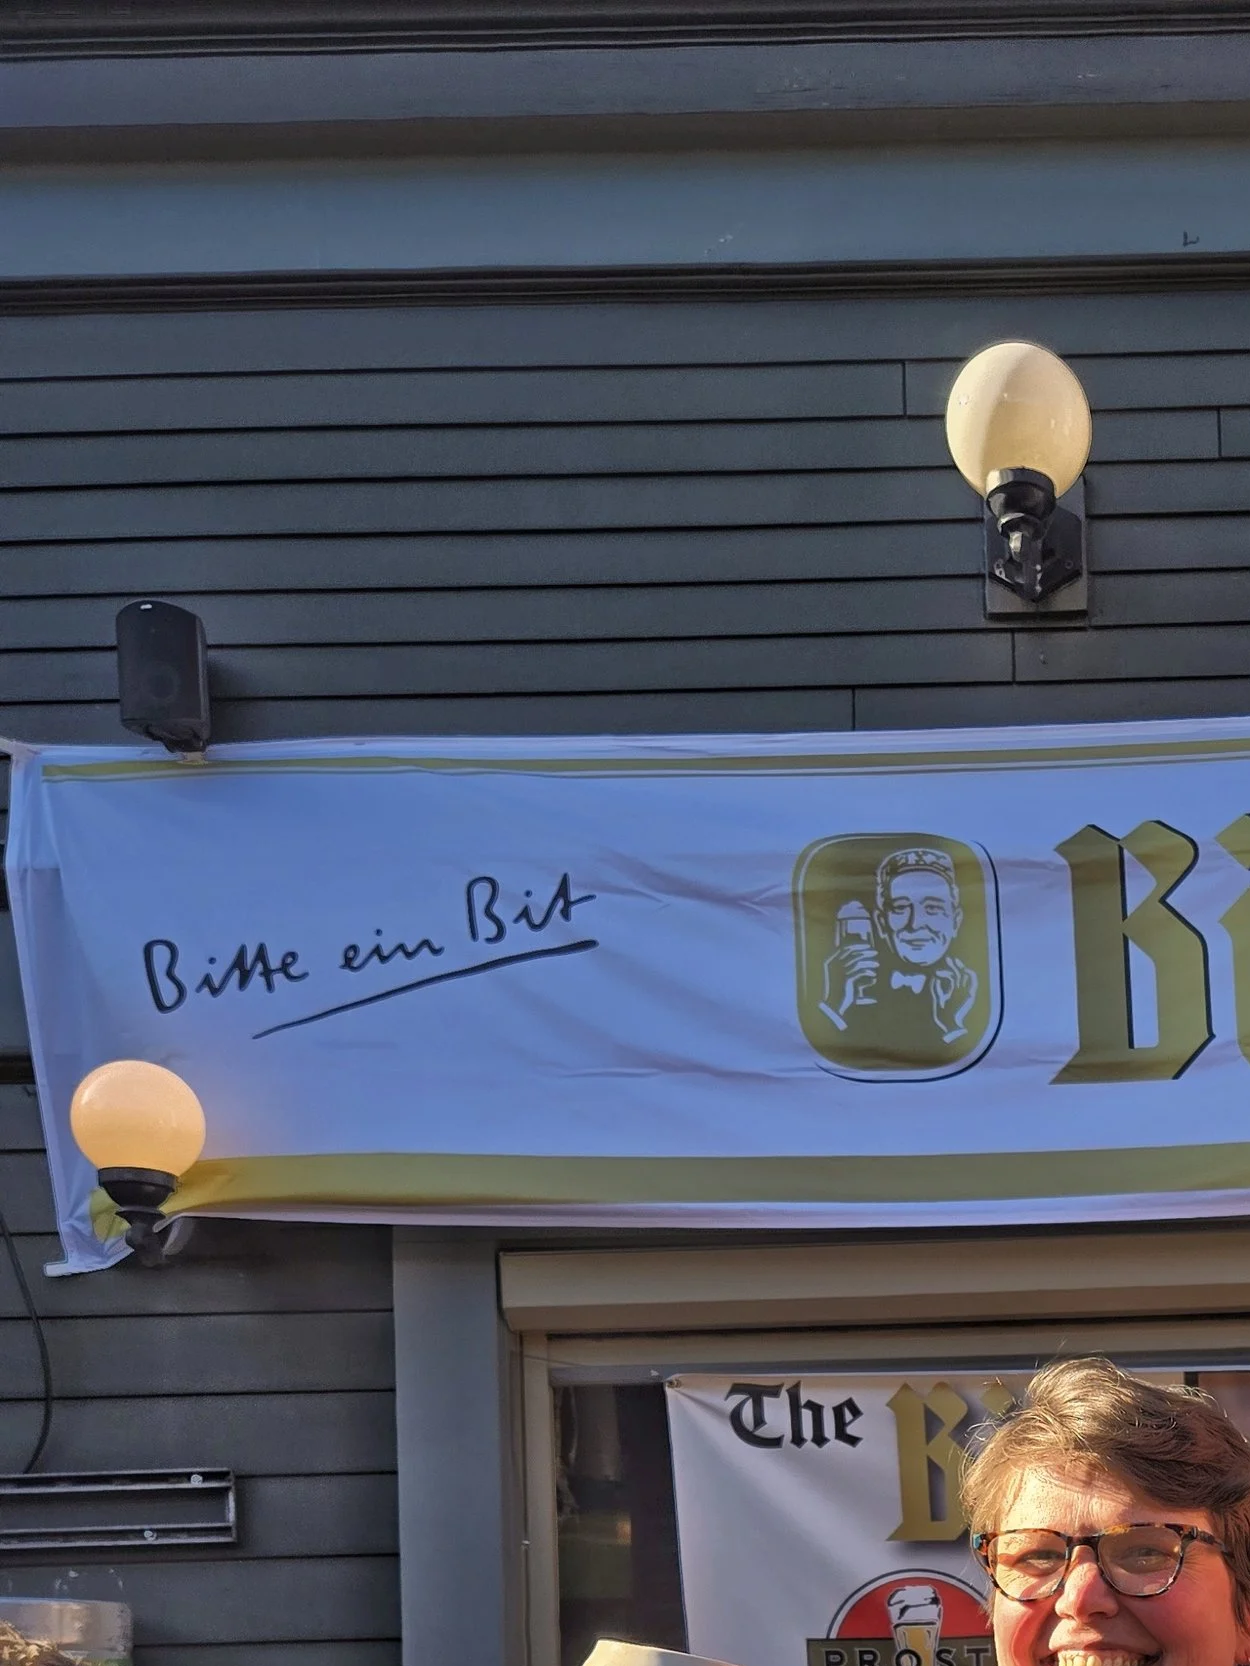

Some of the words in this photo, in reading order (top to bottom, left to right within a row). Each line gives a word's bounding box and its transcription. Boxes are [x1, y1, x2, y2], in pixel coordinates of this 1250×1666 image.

[142, 938, 309, 1014] Bitte
[339, 928, 445, 971] ein
[465, 873, 597, 944] Bit
[724, 1381, 865, 1450] The
